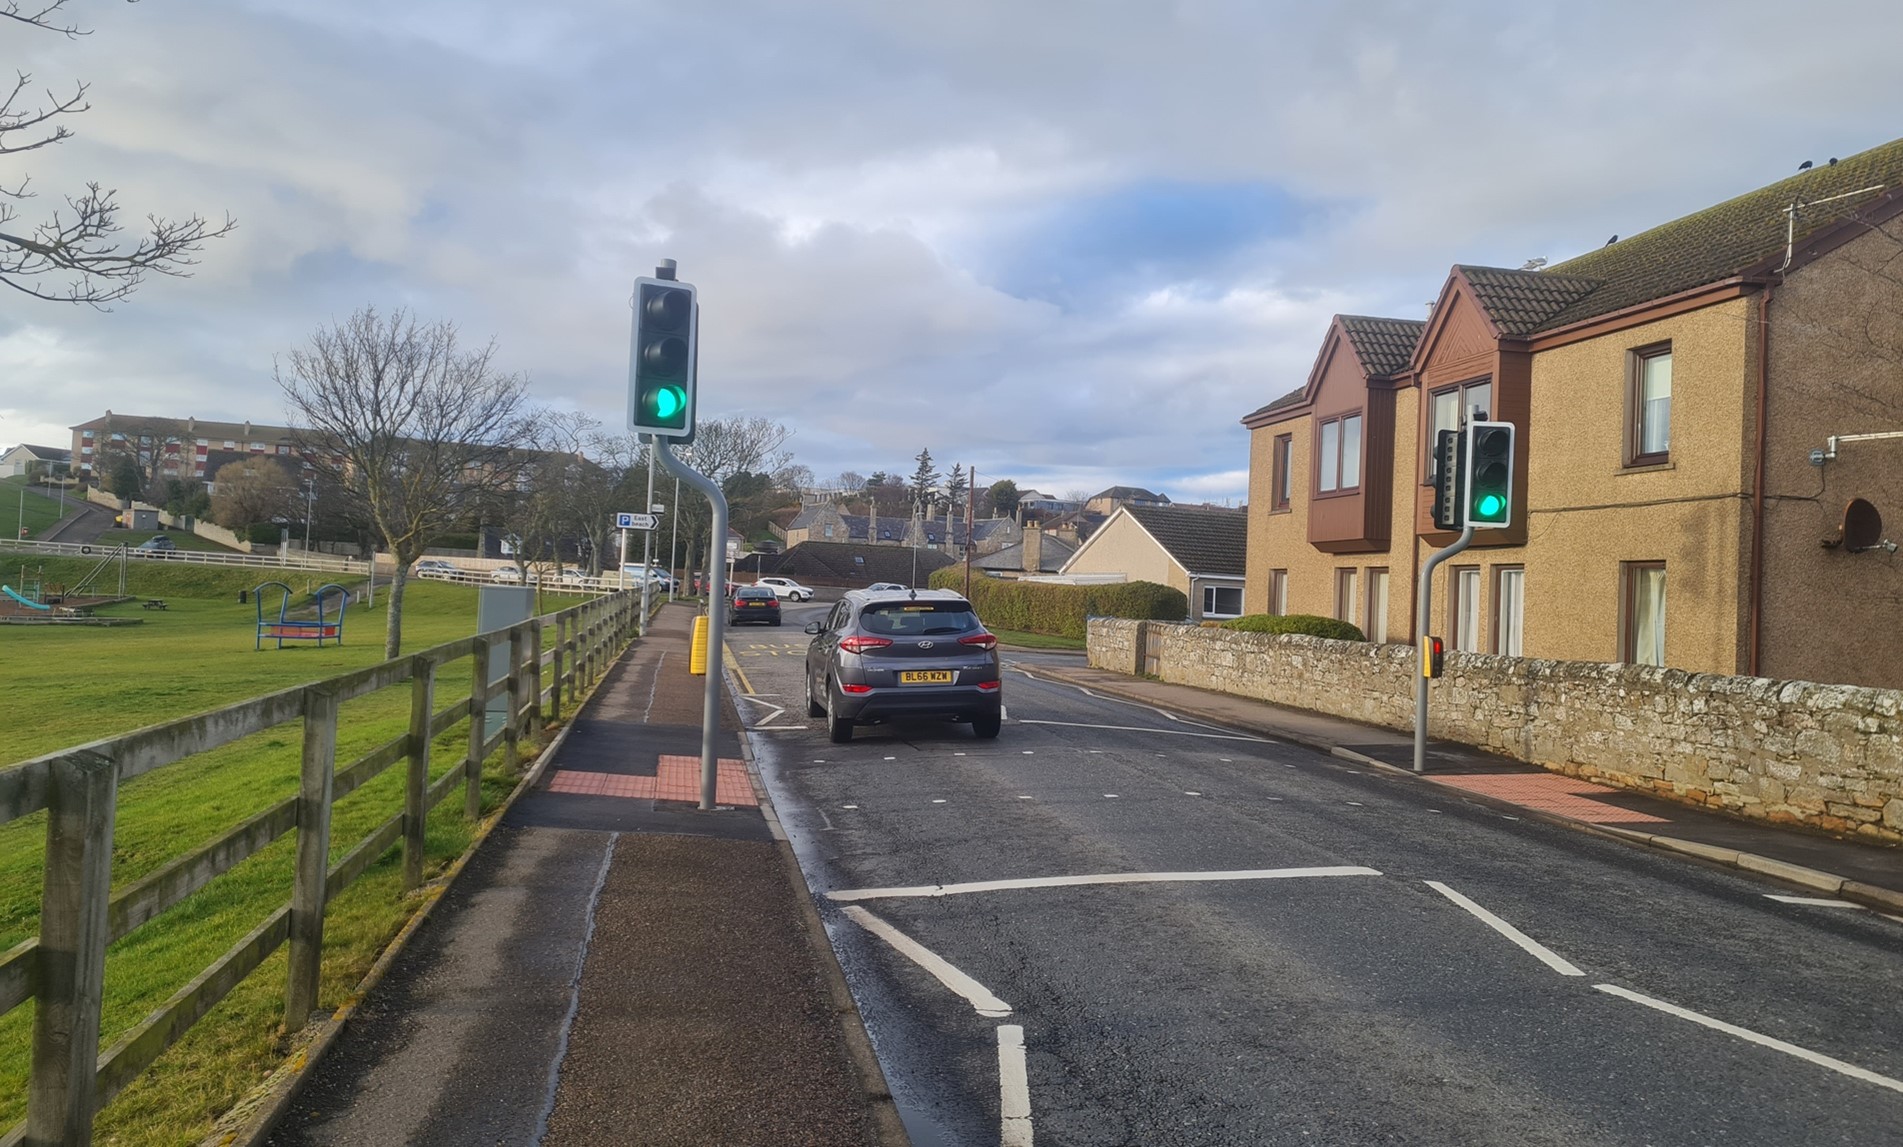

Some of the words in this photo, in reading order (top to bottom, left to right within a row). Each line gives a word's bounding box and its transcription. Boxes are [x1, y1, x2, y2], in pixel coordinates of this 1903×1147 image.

[621, 516, 629, 525] P
[905, 671, 929, 681] BL66
[930, 671, 948, 681] WZW
